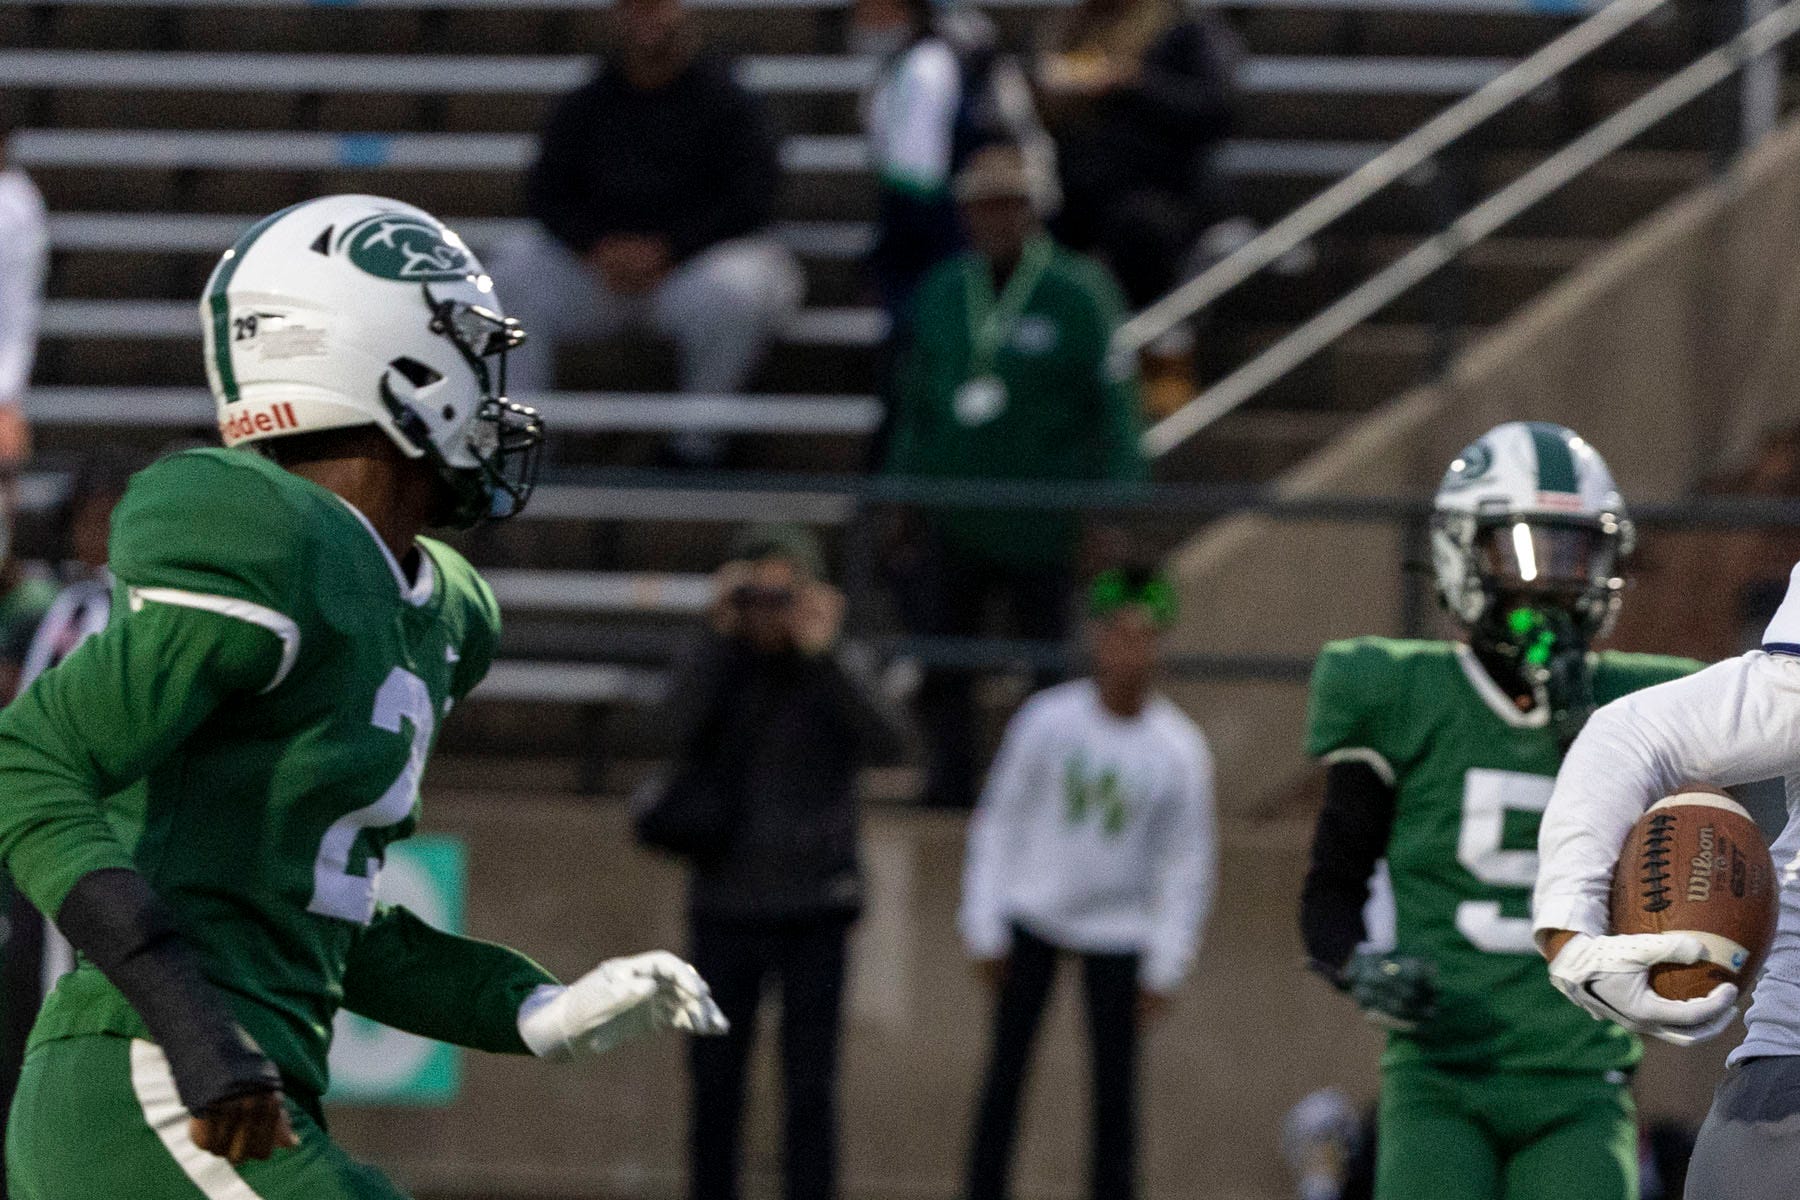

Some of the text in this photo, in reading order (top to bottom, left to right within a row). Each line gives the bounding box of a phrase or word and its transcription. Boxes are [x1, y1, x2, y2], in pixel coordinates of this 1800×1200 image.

[234, 315, 258, 342] 29
[307, 665, 434, 928] 2
[1455, 766, 1556, 954] 5
[1686, 826, 1715, 902] Wilson
